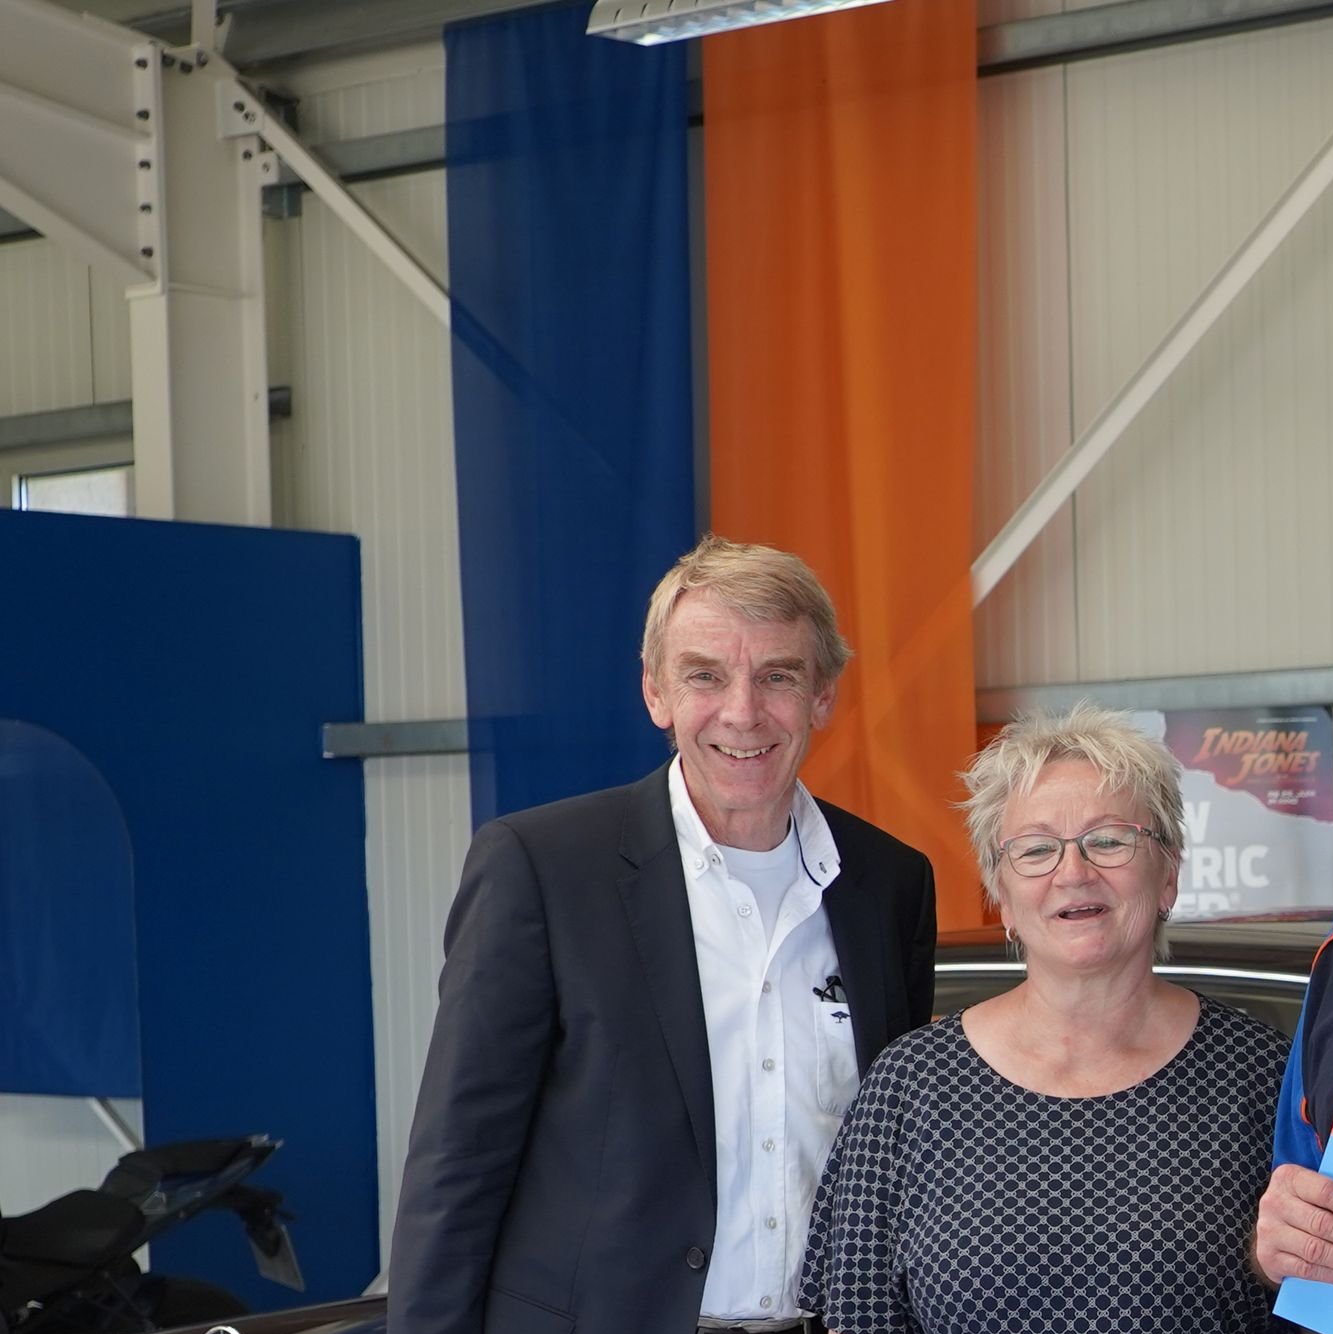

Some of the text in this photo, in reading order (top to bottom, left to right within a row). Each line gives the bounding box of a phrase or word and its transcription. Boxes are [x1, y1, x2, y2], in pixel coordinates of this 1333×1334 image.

[1193, 727, 1310, 763] INDIANA
[1225, 752, 1321, 786] JONES
[1181, 845, 1270, 890] RIC
